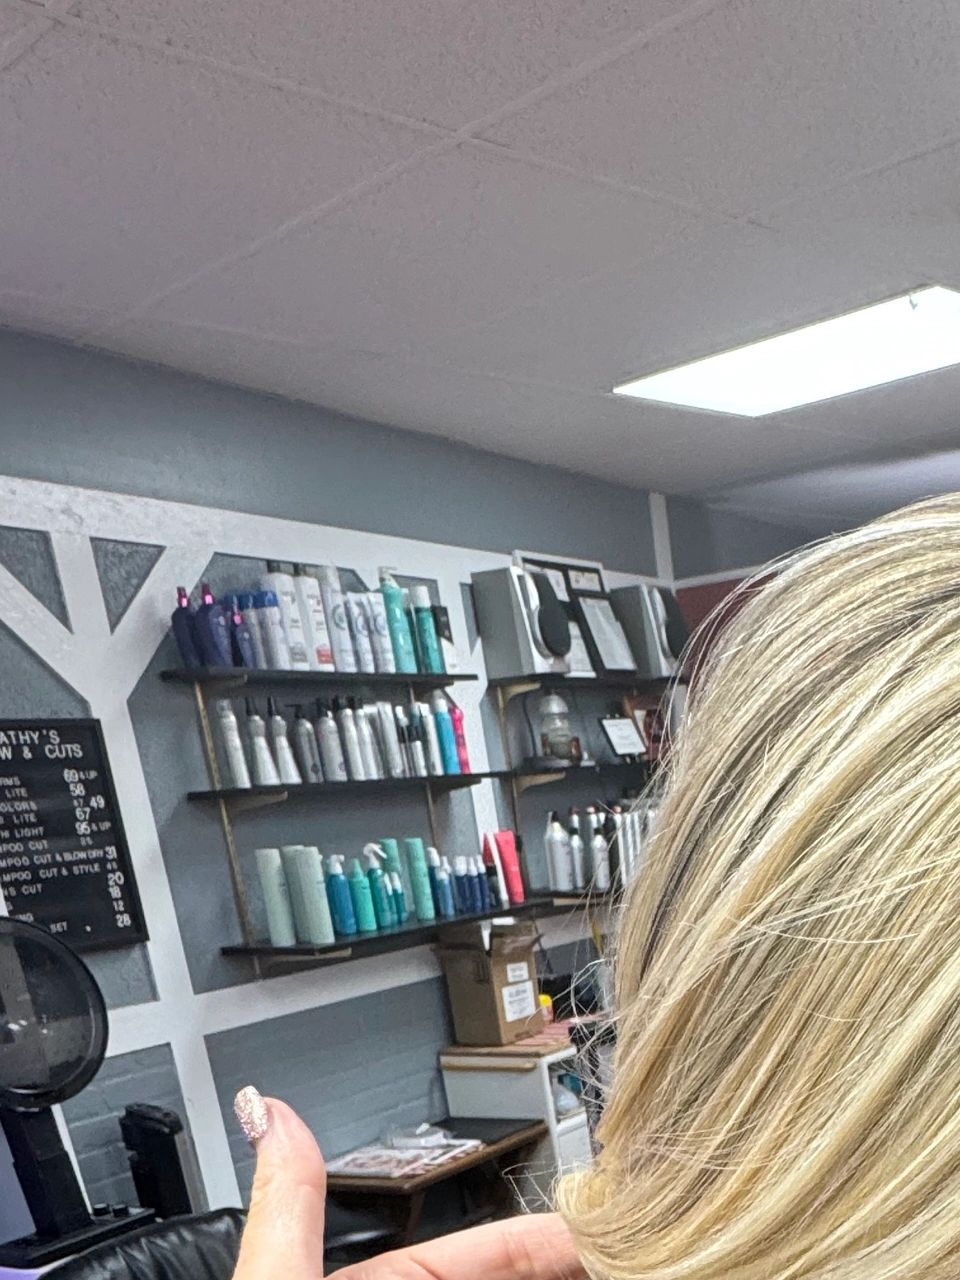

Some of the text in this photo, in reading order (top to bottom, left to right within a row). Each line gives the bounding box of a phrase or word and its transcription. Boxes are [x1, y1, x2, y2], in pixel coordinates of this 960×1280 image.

[22, 746, 33, 760] &
[44, 743, 83, 759] CUTS
[75, 807, 91, 821] 67
[14, 826, 44, 839] LIGHT
[28, 839, 48, 851] CUT
[33, 853, 52, 865] CUT
[0, 870, 32, 882] MPOO
[39, 867, 58, 879] CUT
[72, 863, 100, 876] STYLE
[21, 883, 42, 895] CUT
[107, 871, 124, 886] 20
